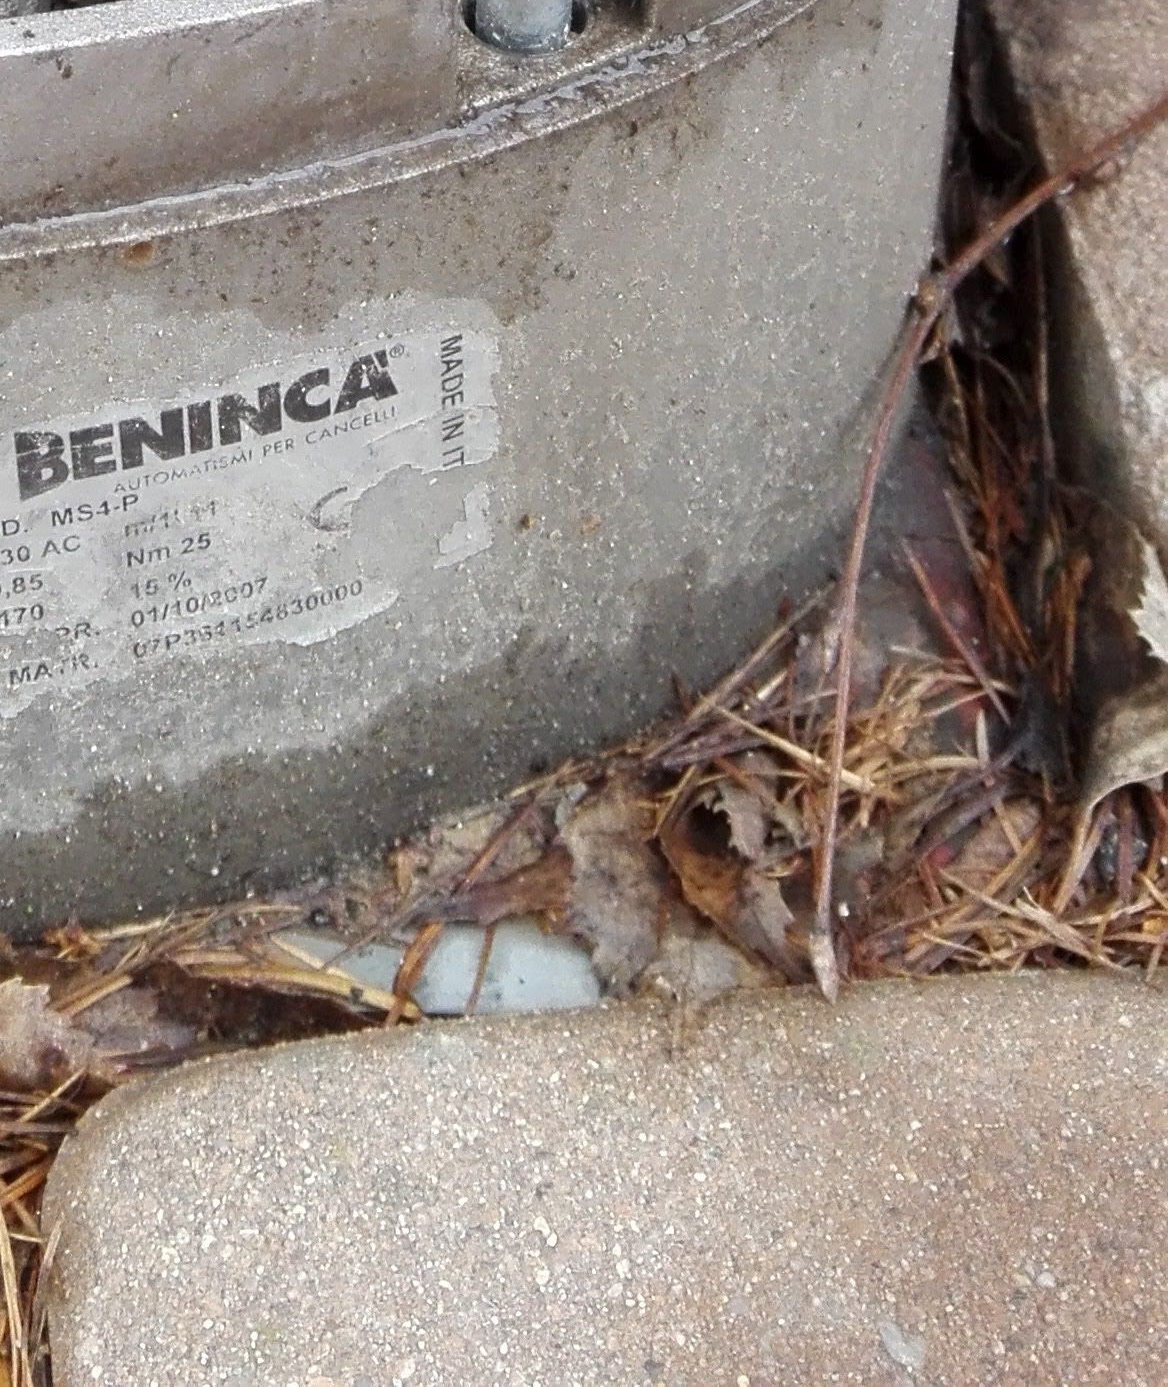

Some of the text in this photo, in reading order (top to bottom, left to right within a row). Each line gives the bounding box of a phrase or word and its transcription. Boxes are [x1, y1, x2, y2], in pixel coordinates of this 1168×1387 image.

[440, 334, 465, 410] MADE
[441, 414, 465, 442] IN
[114, 405, 396, 494] AUTOMATISMI PER CANCELLI
[50, 494, 139, 528] MS4-P
[40, 535, 82, 558] AC
[126, 532, 212, 568] Nm 25
